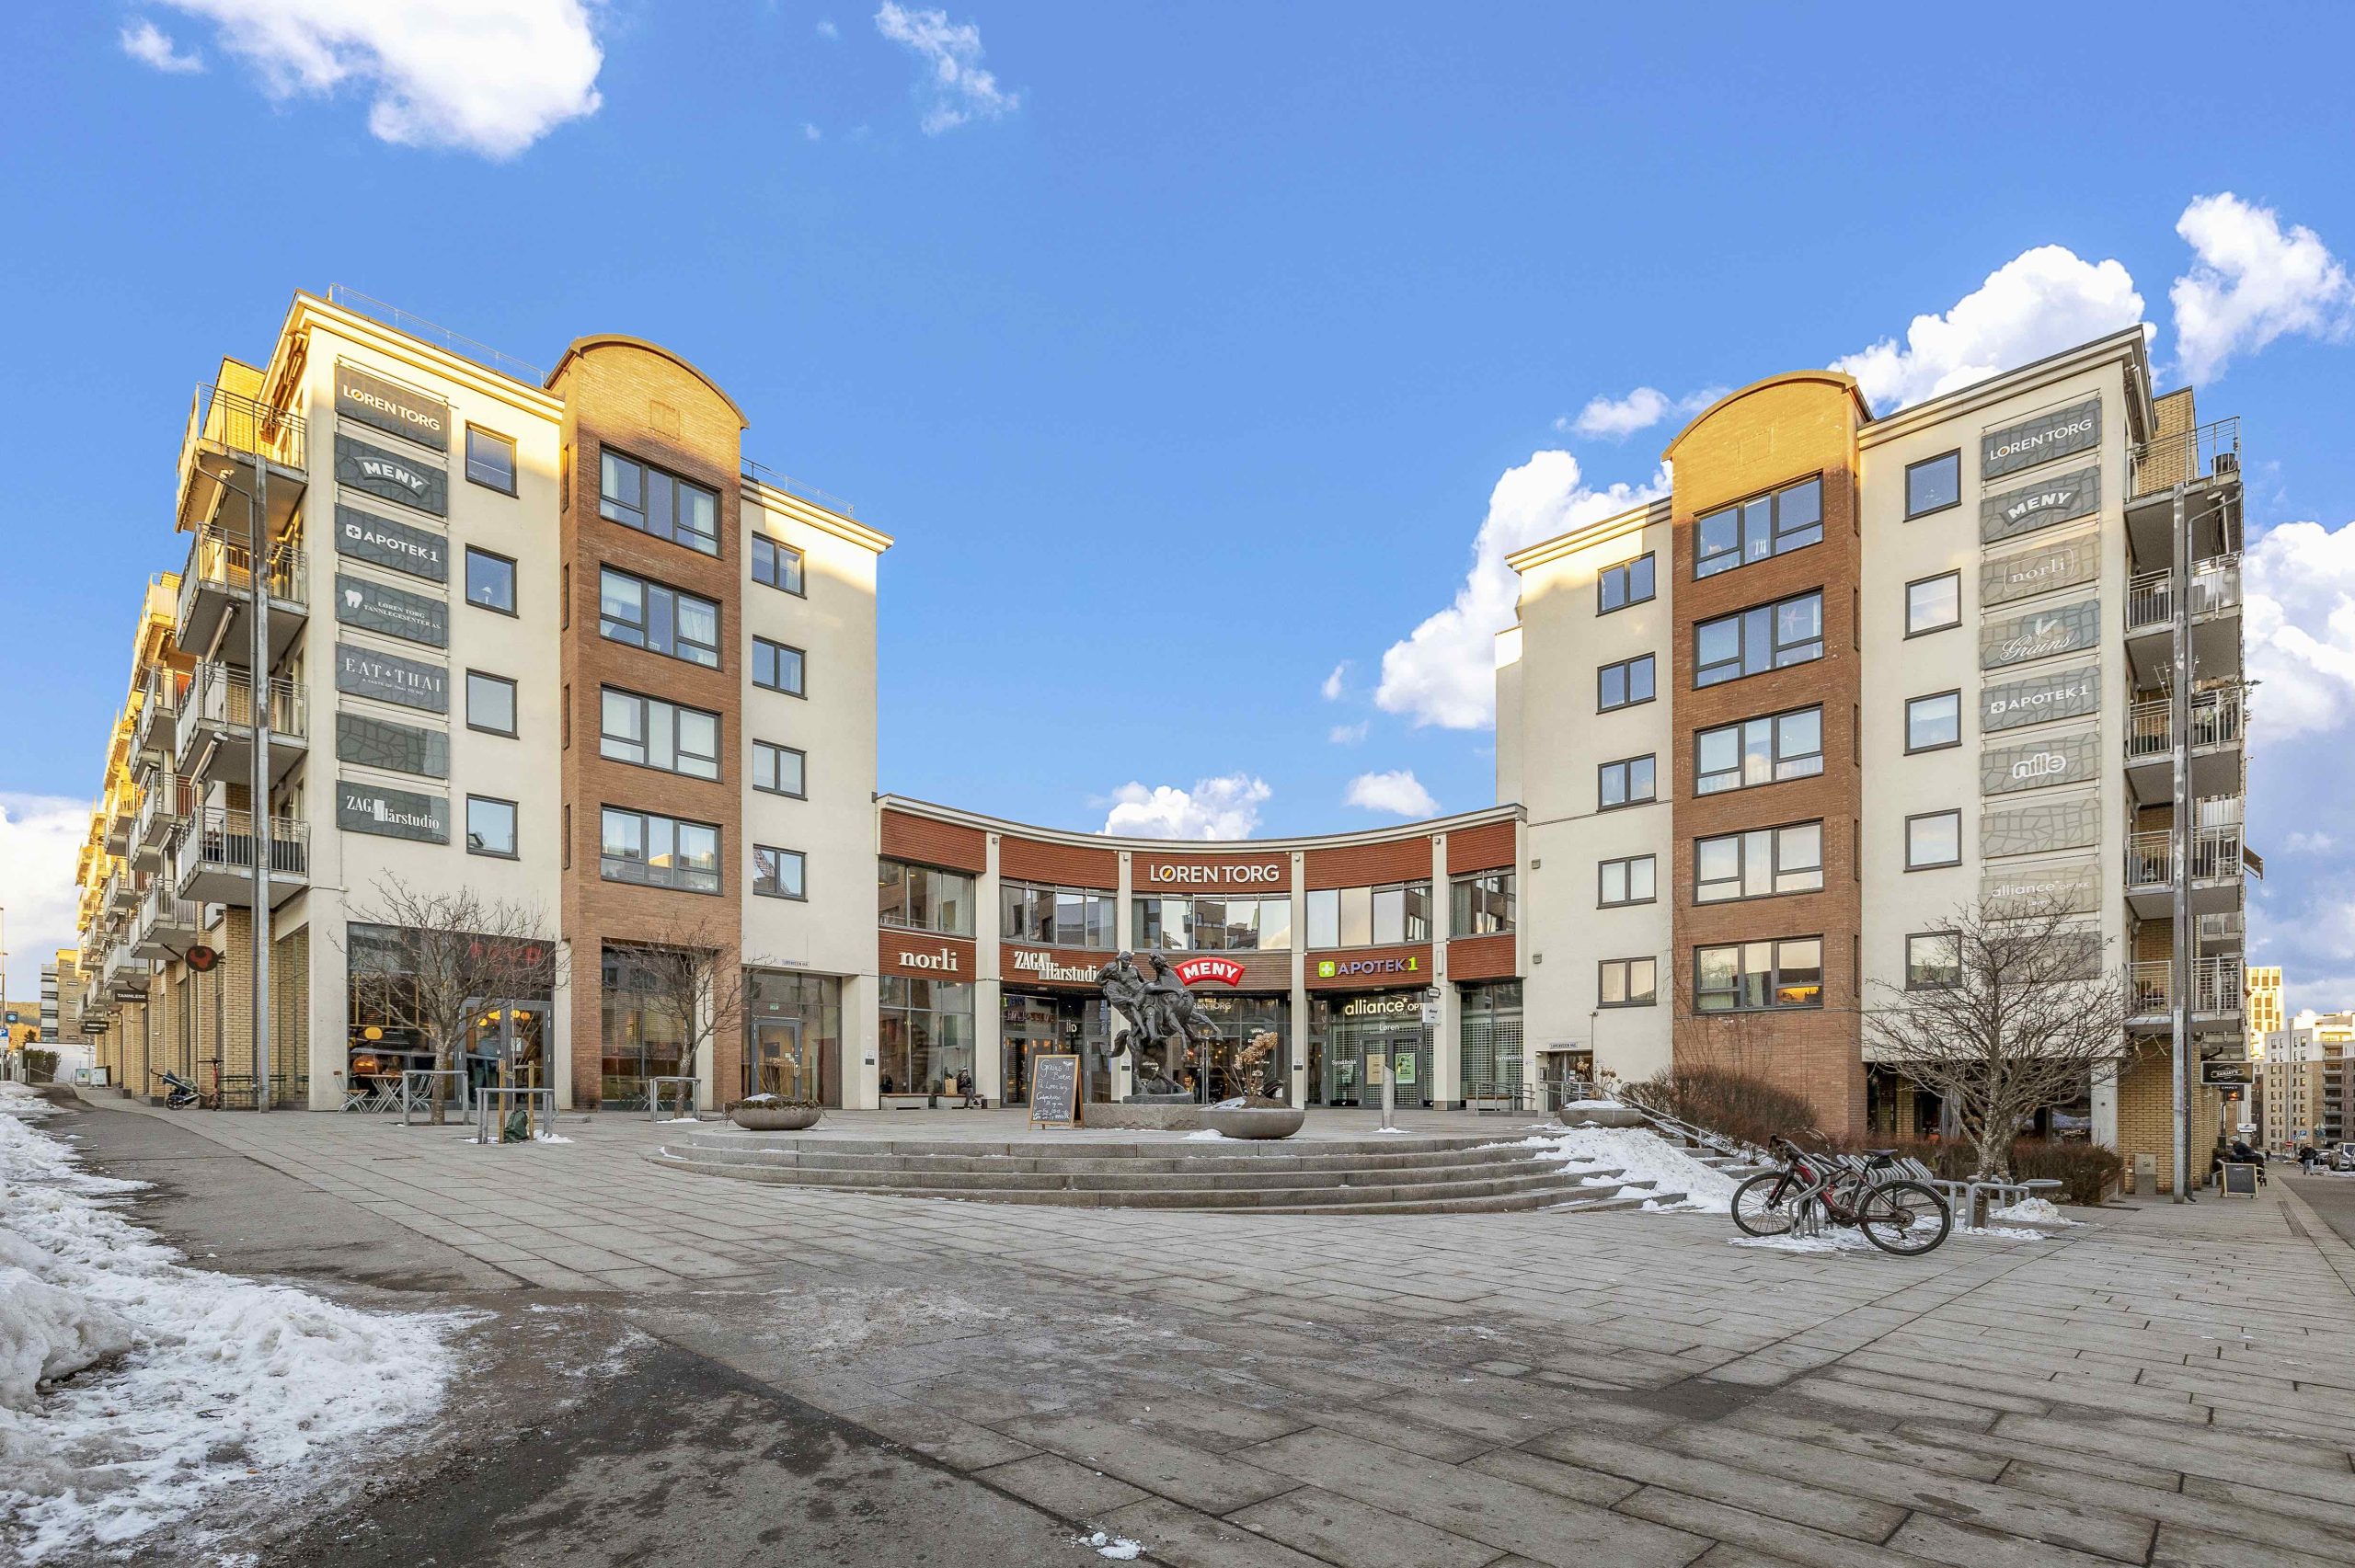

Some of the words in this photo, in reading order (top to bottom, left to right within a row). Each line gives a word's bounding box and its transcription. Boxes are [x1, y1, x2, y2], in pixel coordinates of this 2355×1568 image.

[398, 405, 441, 431] TORG
[2045, 418, 2092, 442] TORG
[362, 462, 424, 489] MENY
[2007, 492, 2073, 520] MENY
[363, 528, 429, 559] APOTEK
[430, 551, 439, 563] 1
[2011, 556, 2066, 584] norli
[363, 604, 431, 627] TANNLEGESENTER
[406, 609, 425, 619] TORG
[1999, 632, 2075, 661] Grains
[346, 658, 382, 678] EAT
[395, 669, 441, 692] THAI
[2008, 687, 2076, 711] APOTEK
[2078, 684, 2089, 696] 1
[2012, 752, 2067, 780] nille
[1150, 864, 1219, 883] LØREN
[1221, 864, 1280, 883] TORG
[898, 948, 959, 972] norli
[1014, 951, 1046, 971] ZAGA
[1045, 962, 1101, 983] Hårstudi
[1183, 961, 1238, 980] MENY
[1338, 958, 1407, 976] APOTEK
[1407, 956, 1419, 972] 1
[1210, 1001, 1232, 1010] TORG
[1344, 999, 1405, 1016] alliance
[1407, 1002, 1424, 1012] OPT
